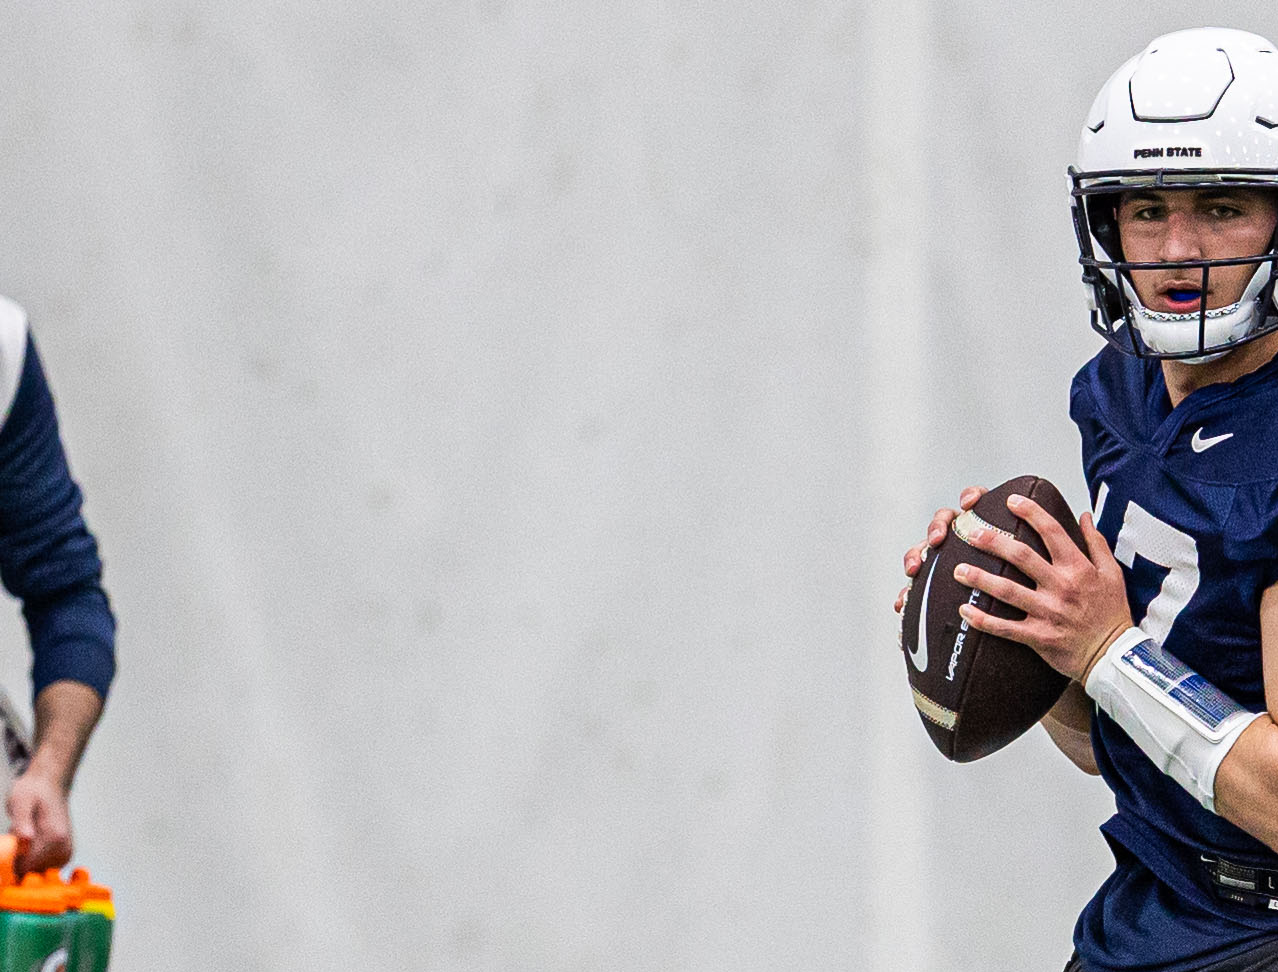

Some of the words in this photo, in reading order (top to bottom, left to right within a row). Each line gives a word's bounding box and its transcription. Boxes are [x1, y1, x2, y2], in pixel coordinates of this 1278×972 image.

[1133, 147, 1164, 159] PENN
[1166, 147, 1202, 157] STATE
[1092, 480, 1201, 648] 7
[945, 632, 967, 682] VAPOR
[960, 587, 981, 632] ETE
[1268, 876, 1275, 890] L
